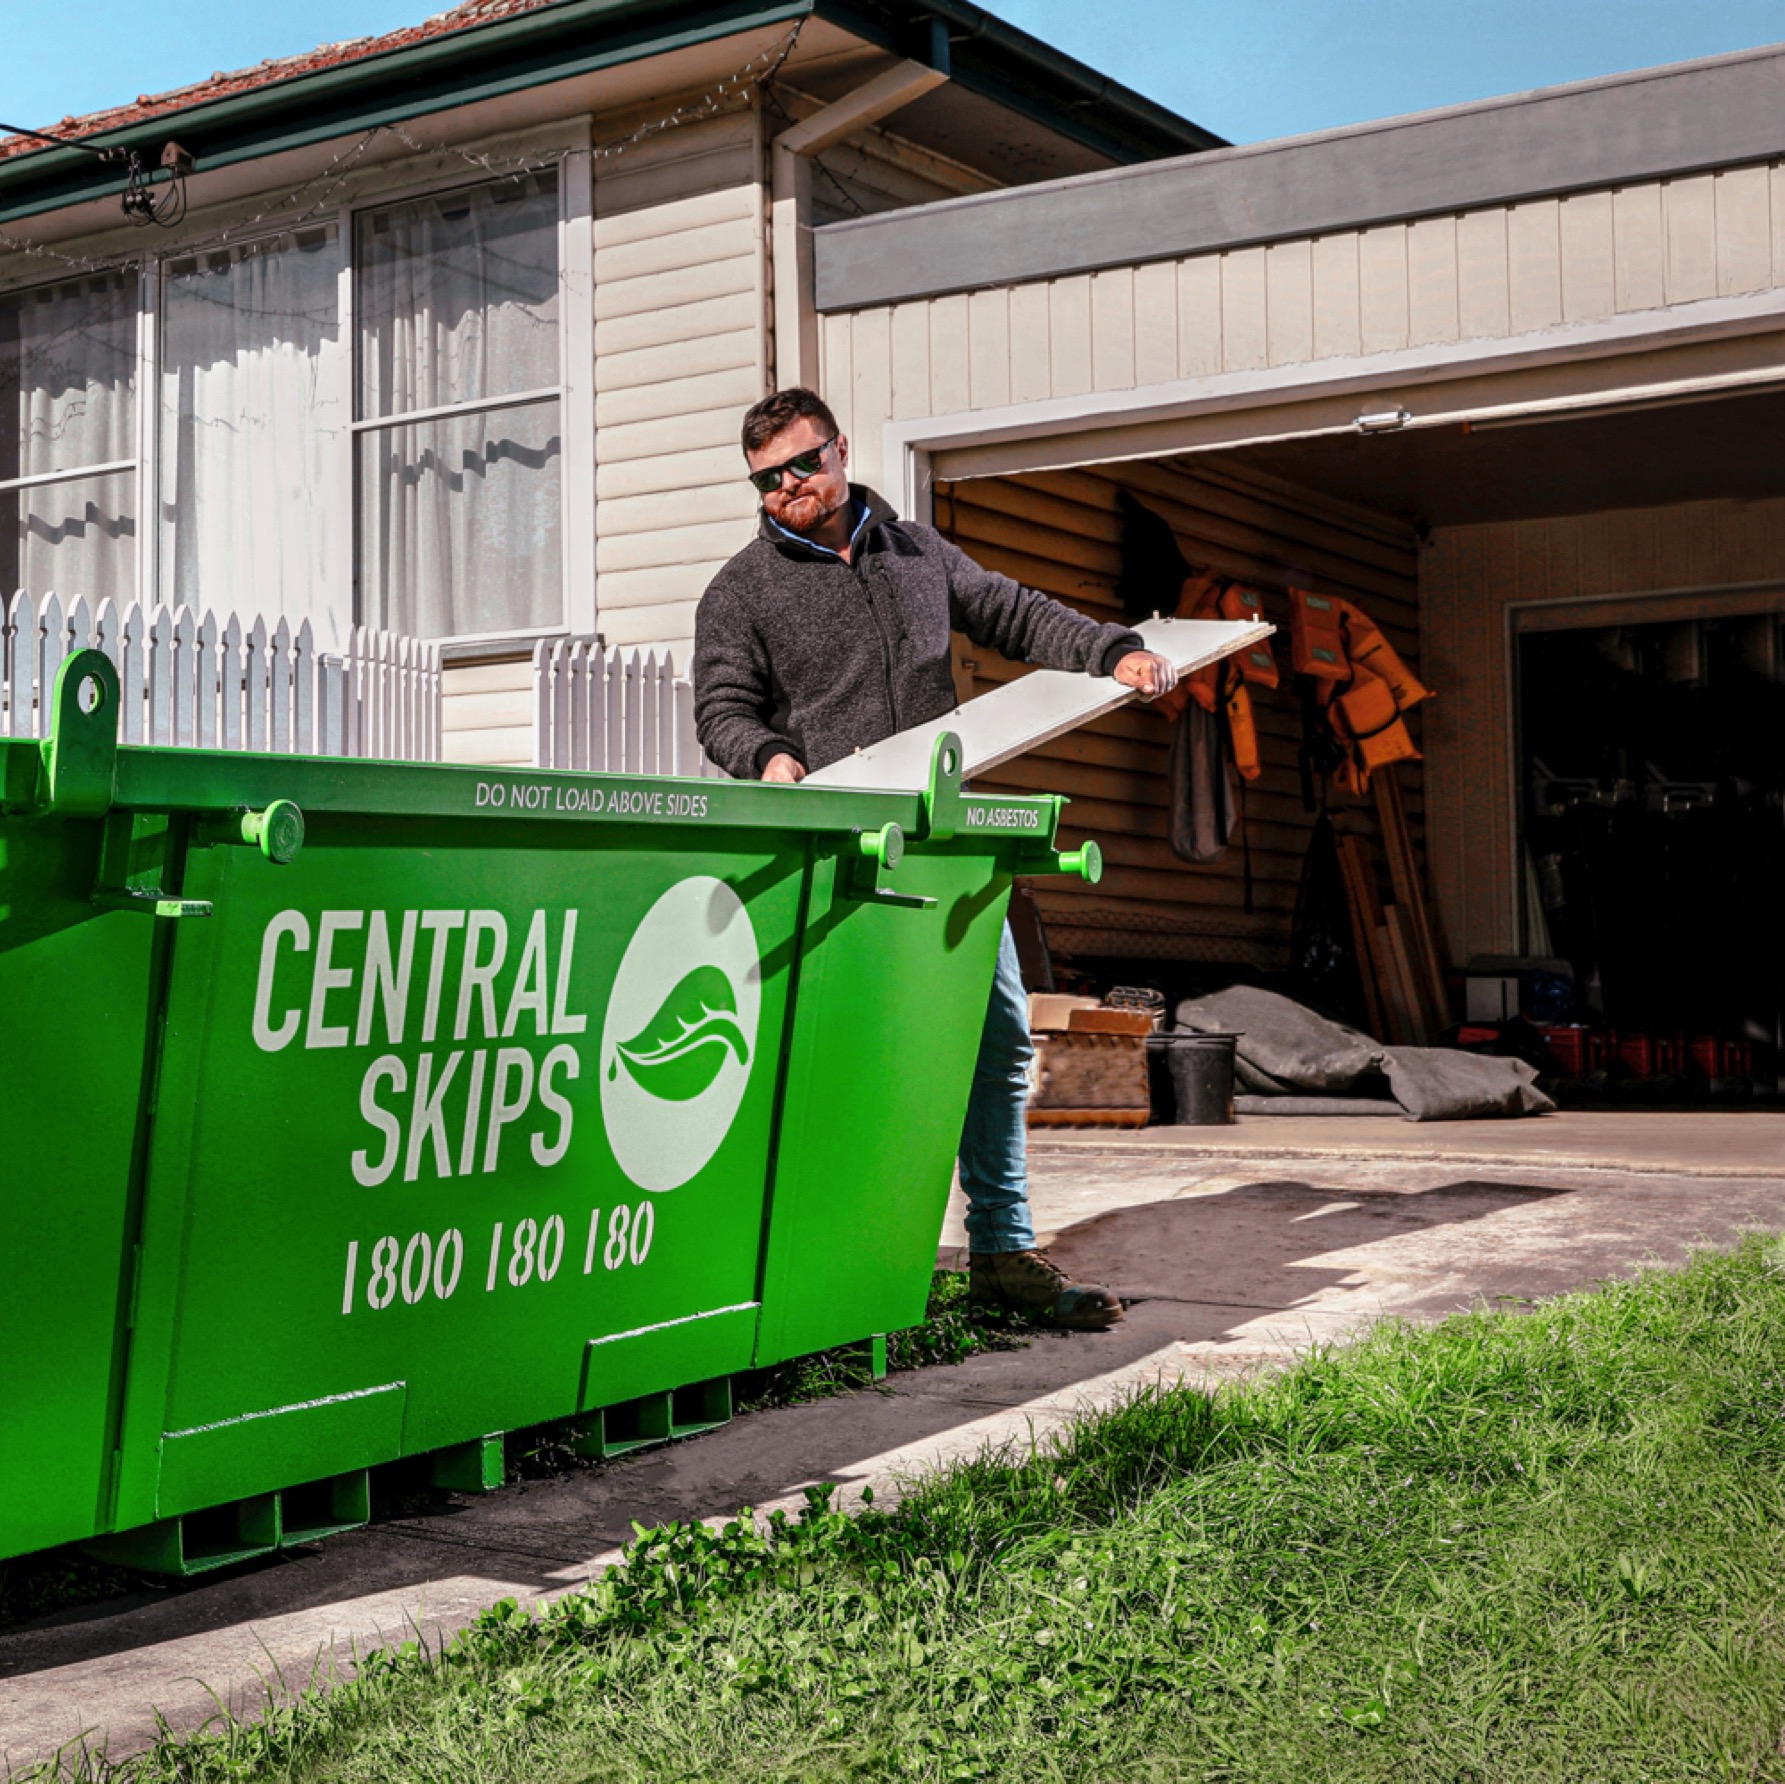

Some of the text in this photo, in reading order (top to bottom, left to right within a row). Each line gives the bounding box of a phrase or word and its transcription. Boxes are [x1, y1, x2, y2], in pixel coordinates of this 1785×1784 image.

[474, 782, 708, 818] DO NOT LOAD ABOVE SIDES
[966, 807, 1039, 828] NO ASBESTOS
[252, 909, 588, 1052] CENTRAL
[351, 1043, 580, 1187] SKIPS
[341, 1200, 655, 1316] 1800 180 180
